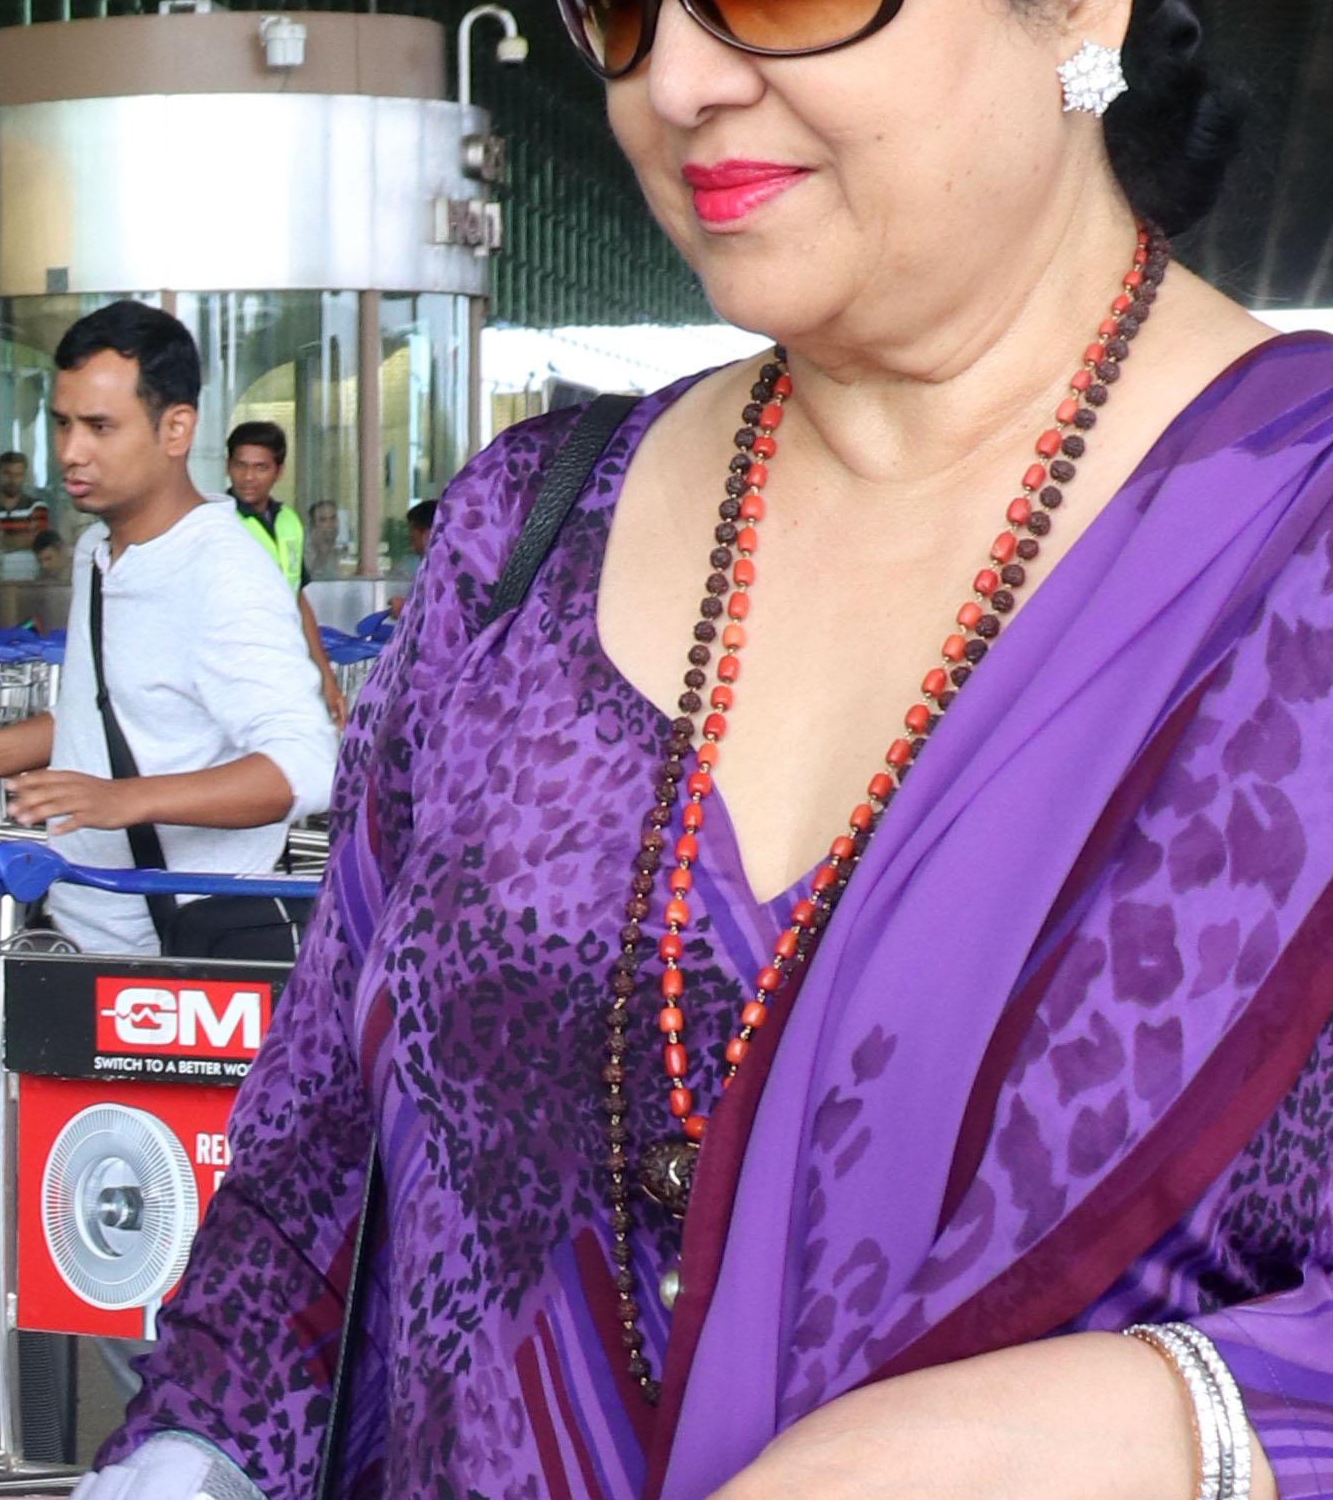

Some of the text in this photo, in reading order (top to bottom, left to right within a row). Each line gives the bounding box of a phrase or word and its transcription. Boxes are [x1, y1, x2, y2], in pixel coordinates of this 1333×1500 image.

[100, 987, 261, 1050] GM
[93, 1055, 143, 1072] SWITCH
[144, 1057, 164, 1073] TO
[165, 1060, 176, 1074] A
[177, 1060, 222, 1076] BETTER
